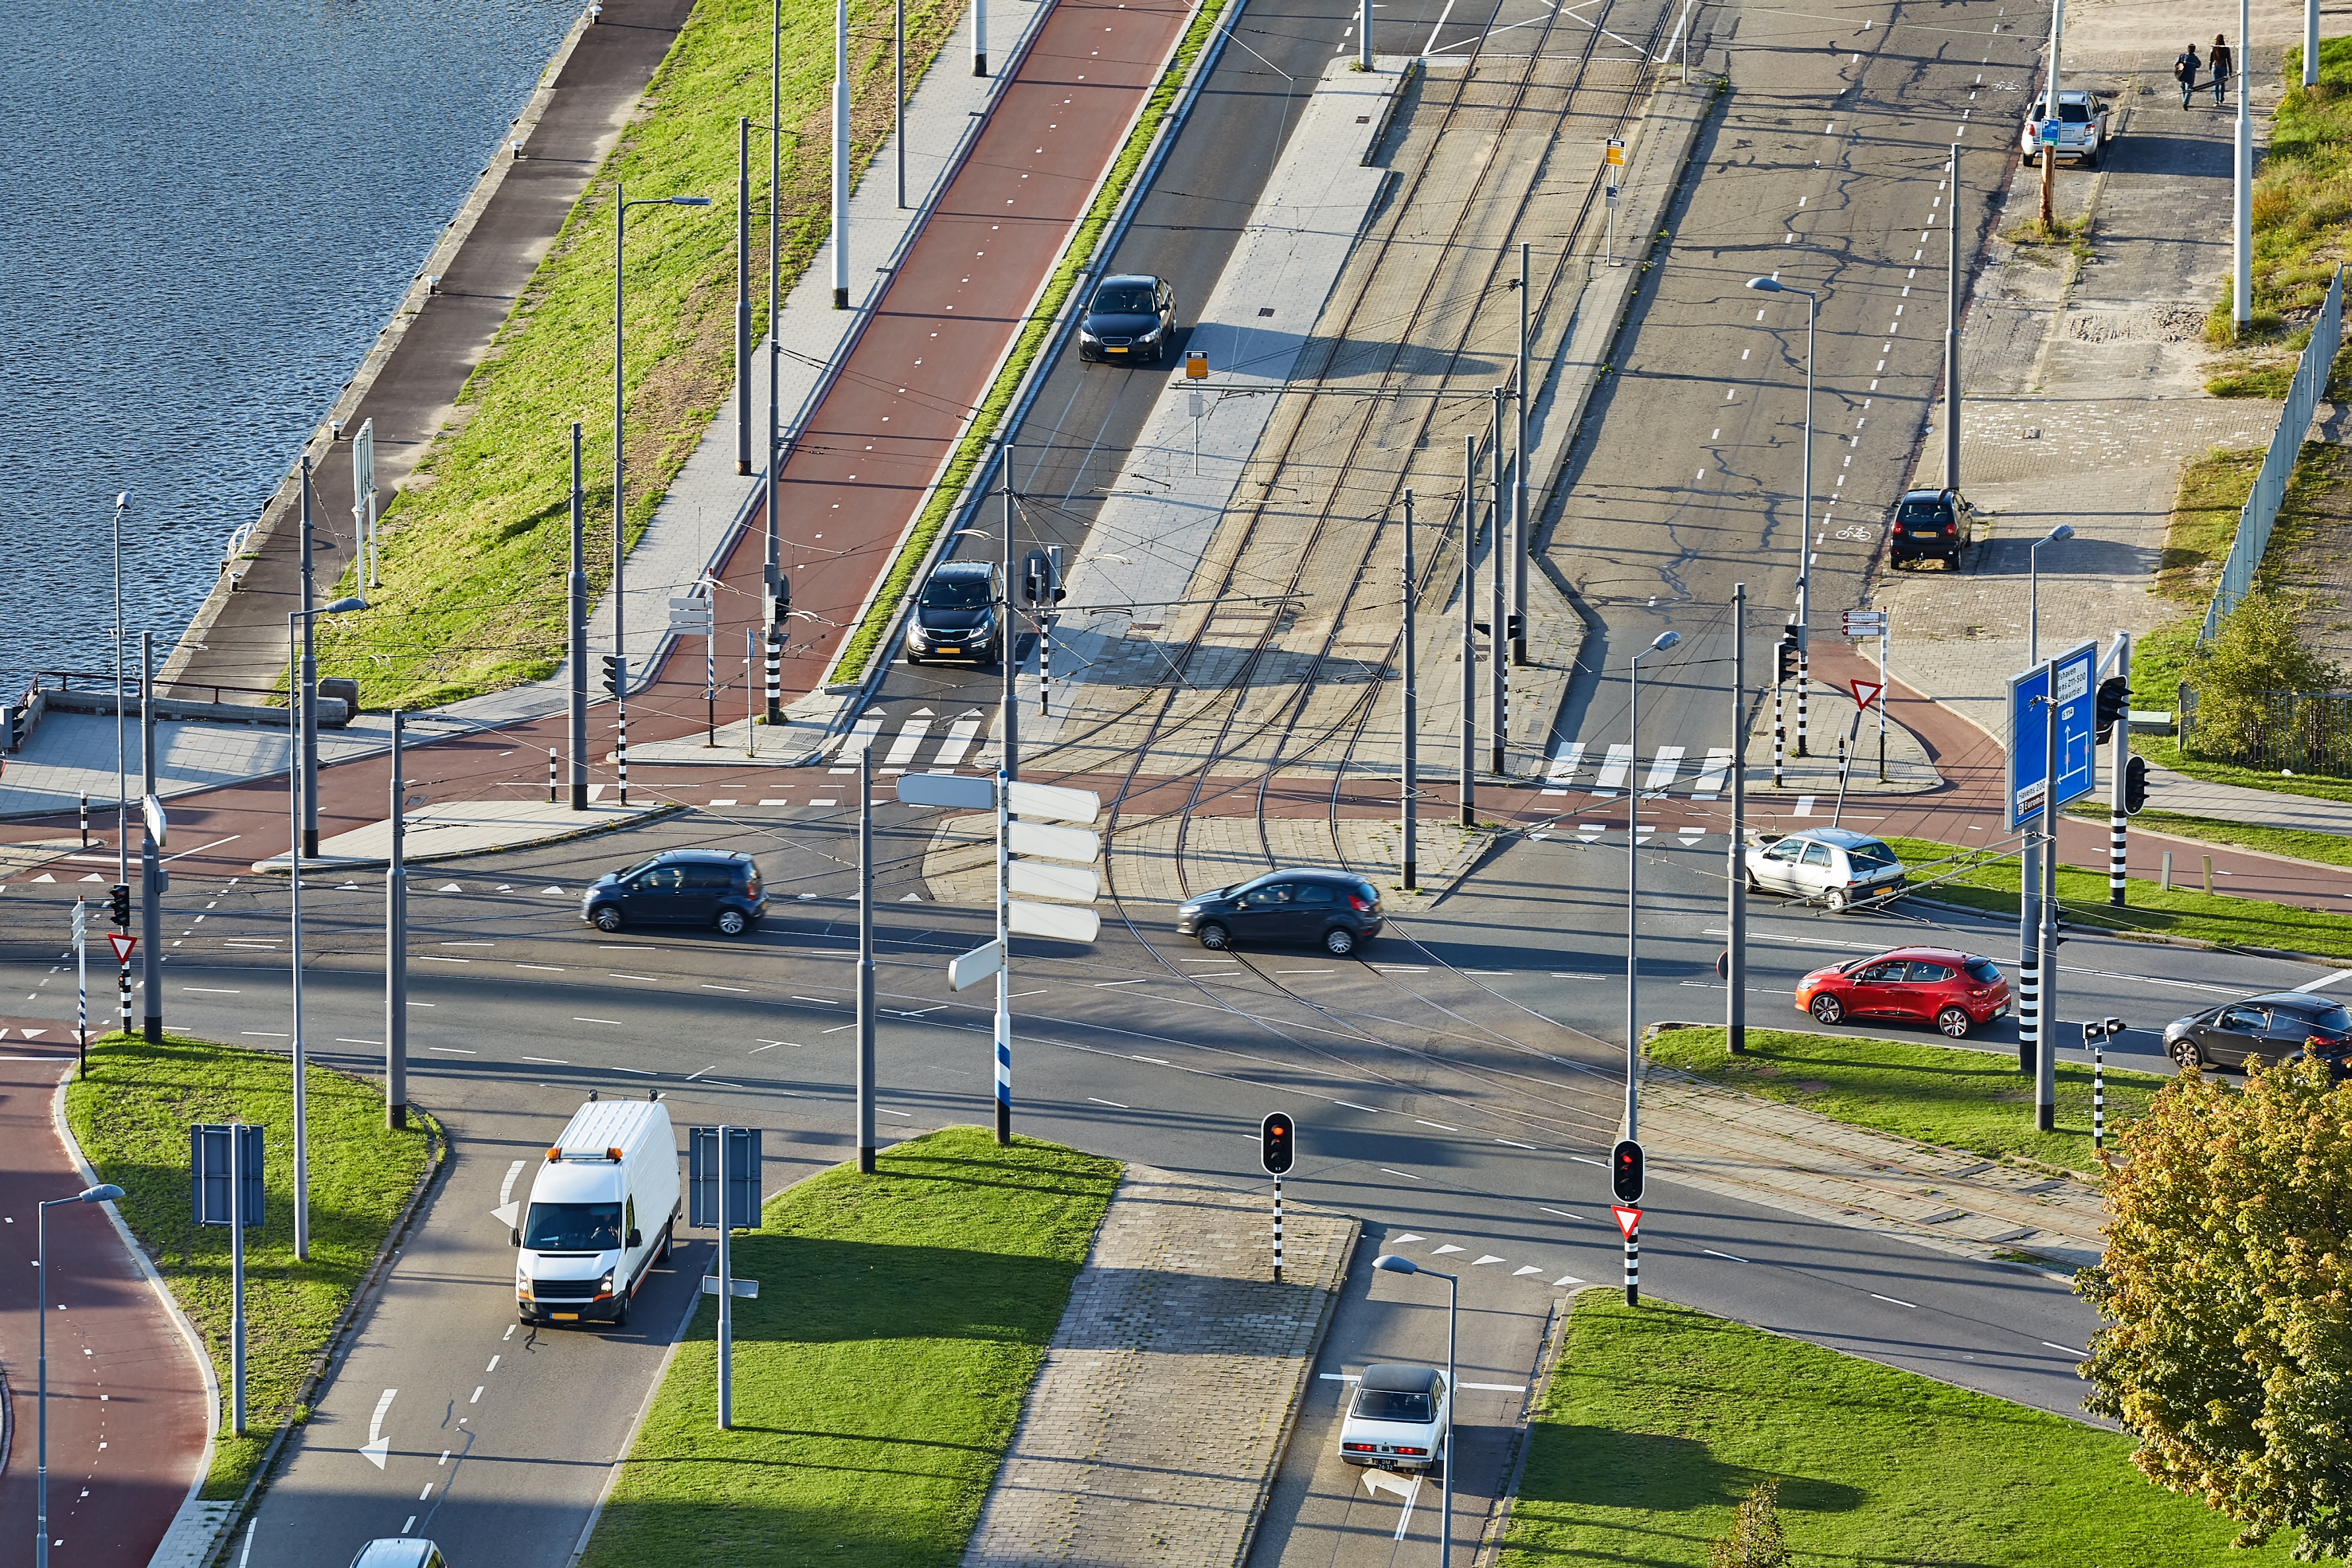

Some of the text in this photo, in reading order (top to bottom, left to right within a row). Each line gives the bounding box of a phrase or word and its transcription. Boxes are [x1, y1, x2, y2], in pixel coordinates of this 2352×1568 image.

[2043, 120, 2049, 128] P
[2058, 668, 2076, 681] fshaven
[2058, 672, 2086, 692] ens 211-500
[2058, 687, 2082, 702] dkwartier
[2018, 781, 2045, 800] Havens 200
[2025, 794, 2045, 810] Euromas
